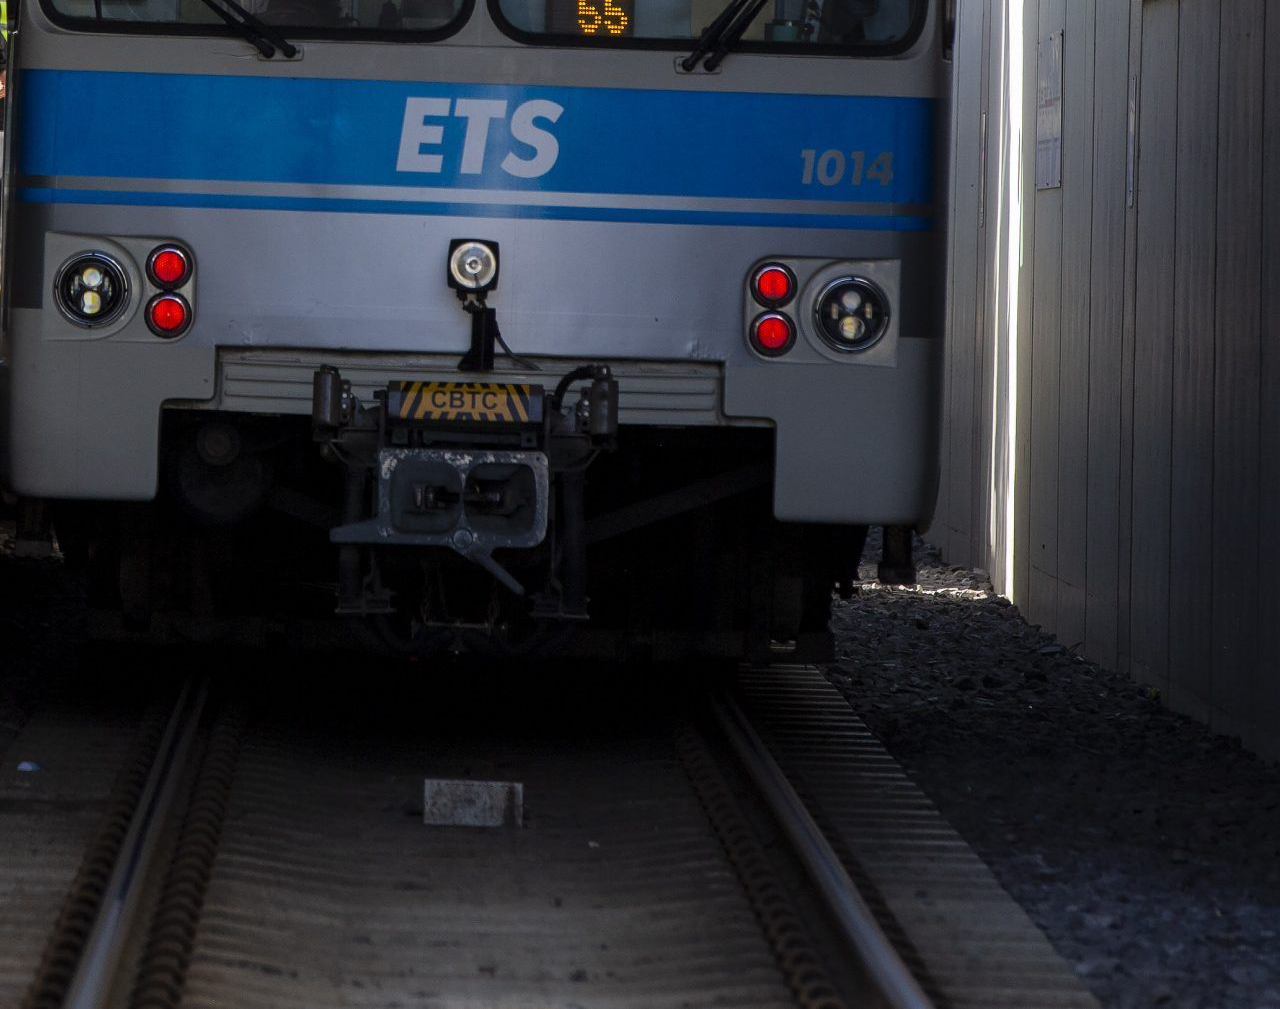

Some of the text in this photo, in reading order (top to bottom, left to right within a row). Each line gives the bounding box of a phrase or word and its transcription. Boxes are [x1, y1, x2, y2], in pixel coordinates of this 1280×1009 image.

[396, 97, 564, 179] ETS
[801, 148, 894, 186] 1014
[431, 390, 498, 409] CBTC
